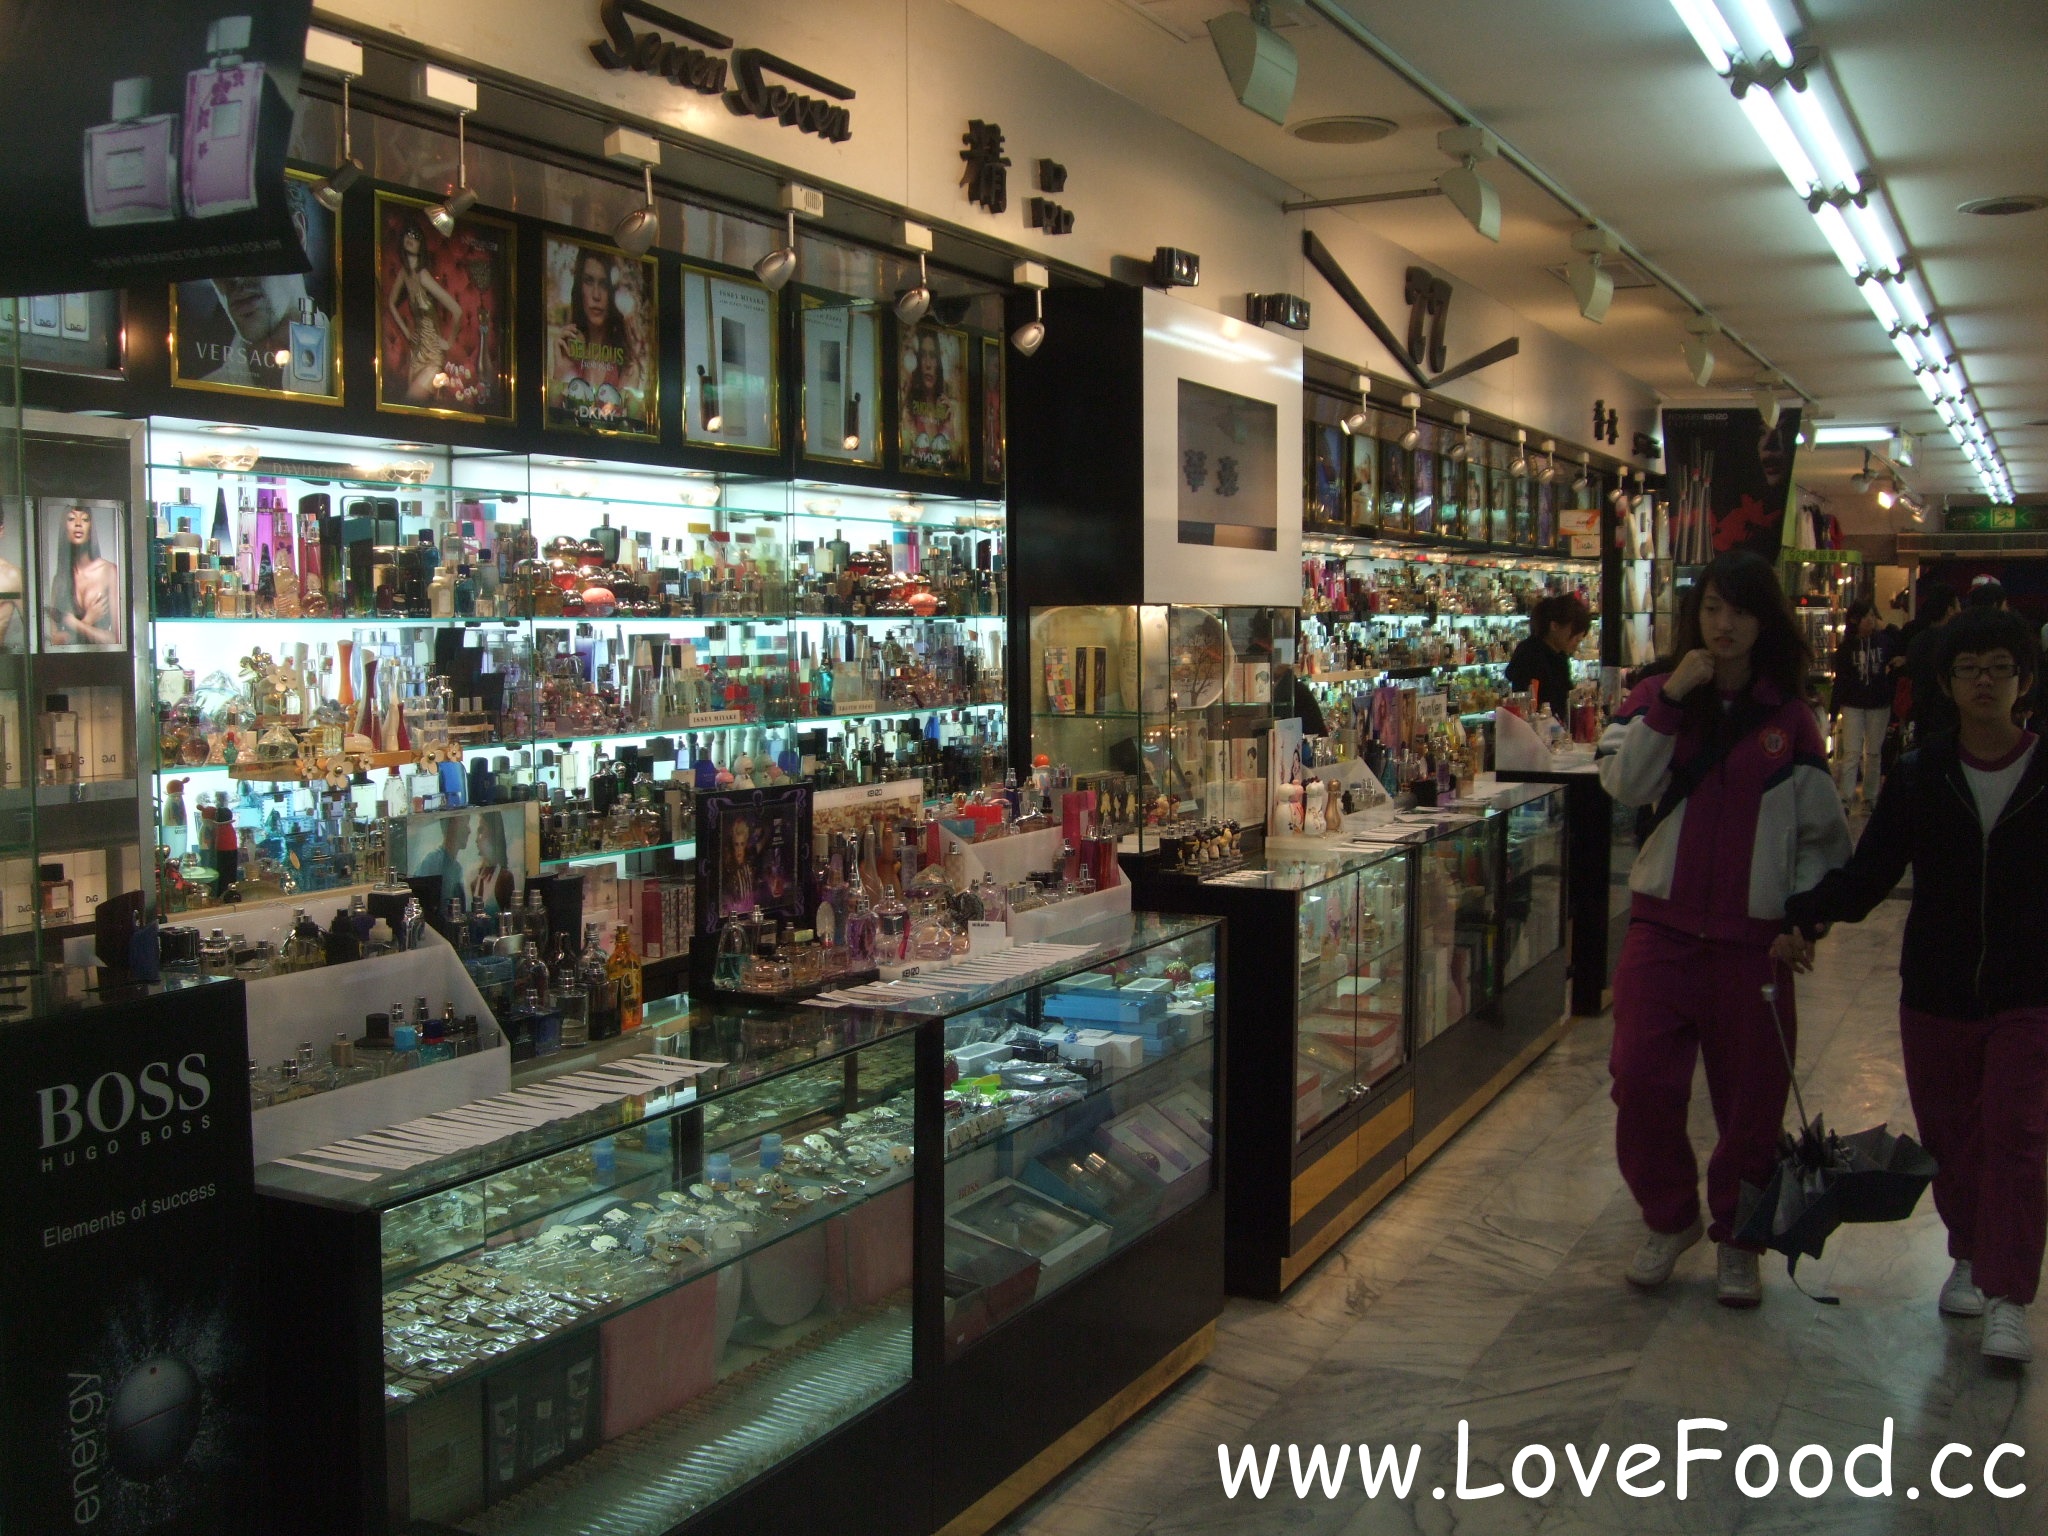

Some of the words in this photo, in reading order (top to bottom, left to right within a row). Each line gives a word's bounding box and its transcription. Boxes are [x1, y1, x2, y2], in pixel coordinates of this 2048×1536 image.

[588, 0, 733, 95] Seven
[721, 47, 856, 143] Seven
[568, 339, 625, 366] DELICIOUS
[579, 404, 617, 422] DKNY
[693, 716, 712, 724] ISSEY
[714, 714, 737, 723] MIYAKE
[36, 1053, 211, 1150] BOSS
[41, 1140, 119, 1173] HUGO
[140, 1114, 210, 1146] BOSS
[43, 1209, 126, 1248] Elements
[131, 1199, 147, 1220] of
[151, 1182, 216, 1214] success
[67, 1373, 104, 1524] energy
